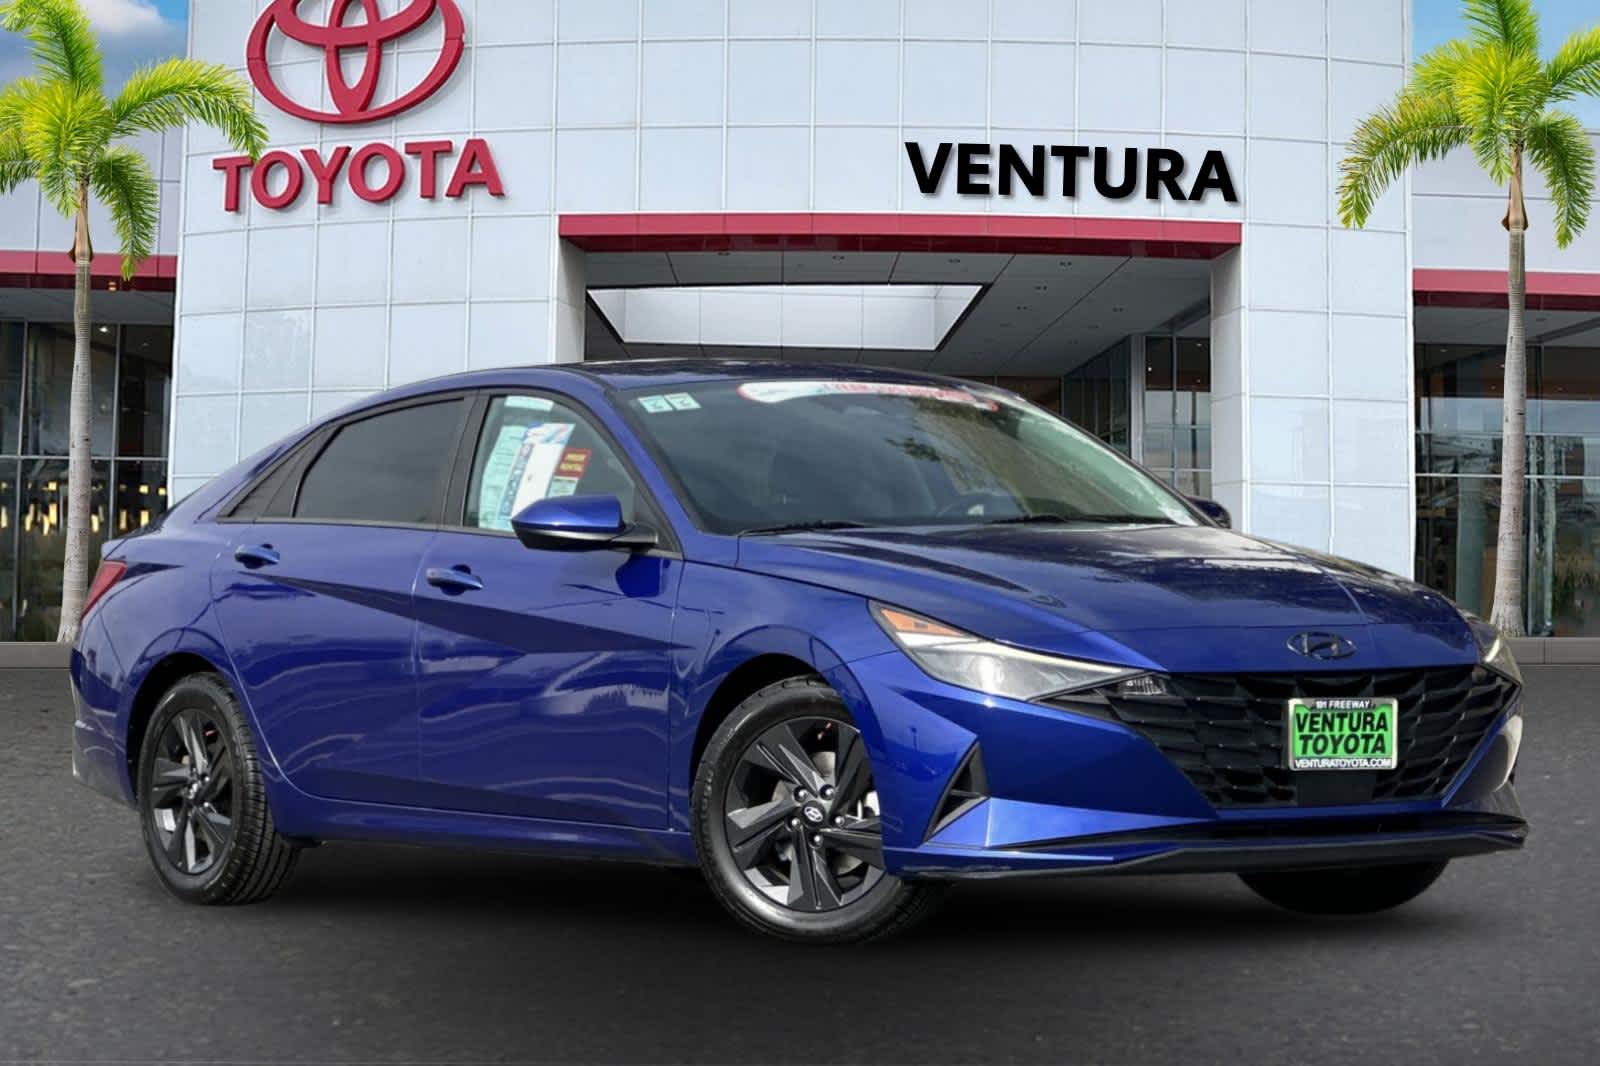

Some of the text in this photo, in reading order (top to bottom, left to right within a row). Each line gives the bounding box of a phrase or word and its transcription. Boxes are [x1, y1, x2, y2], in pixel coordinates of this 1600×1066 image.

[212, 138, 505, 212] TOYOTA
[904, 141, 1239, 202] VENTURA
[1329, 700, 1370, 709] FREEWAY
[1295, 712, 1388, 732] VENTURA
[1299, 734, 1386, 754] TOYOTA
[1294, 758, 1392, 768] VENTURATOYOTA.COM
